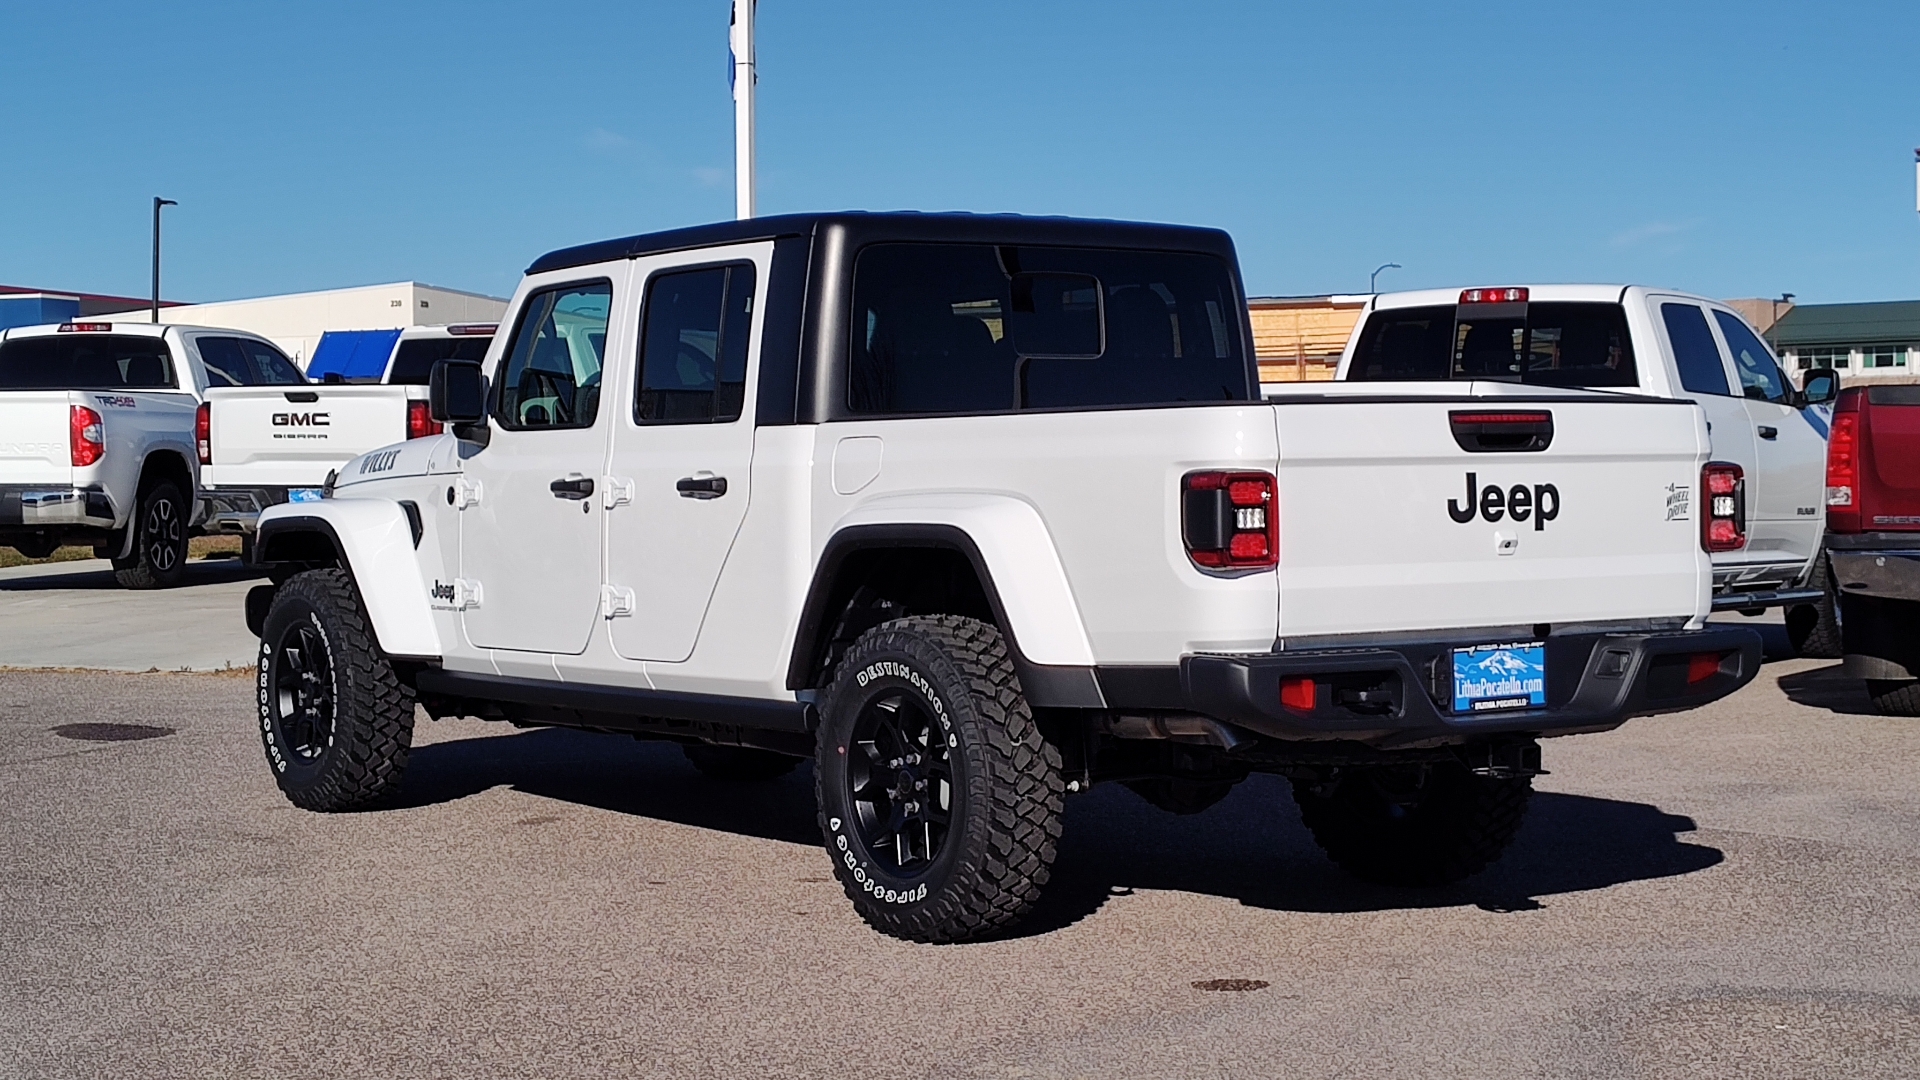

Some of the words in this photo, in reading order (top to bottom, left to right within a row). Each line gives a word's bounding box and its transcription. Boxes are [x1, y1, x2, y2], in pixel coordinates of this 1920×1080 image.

[272, 412, 330, 426] GMC
[359, 449, 401, 474] WILLYS
[1447, 472, 1560, 531] Jeep
[1666, 491, 1689, 507] WHEEL
[1665, 502, 1689, 521] DRIVE
[431, 579, 455, 603] Jeep
[856, 661, 951, 730] DESTINATION
[1456, 675, 1542, 699] LithiaPocatello.com
